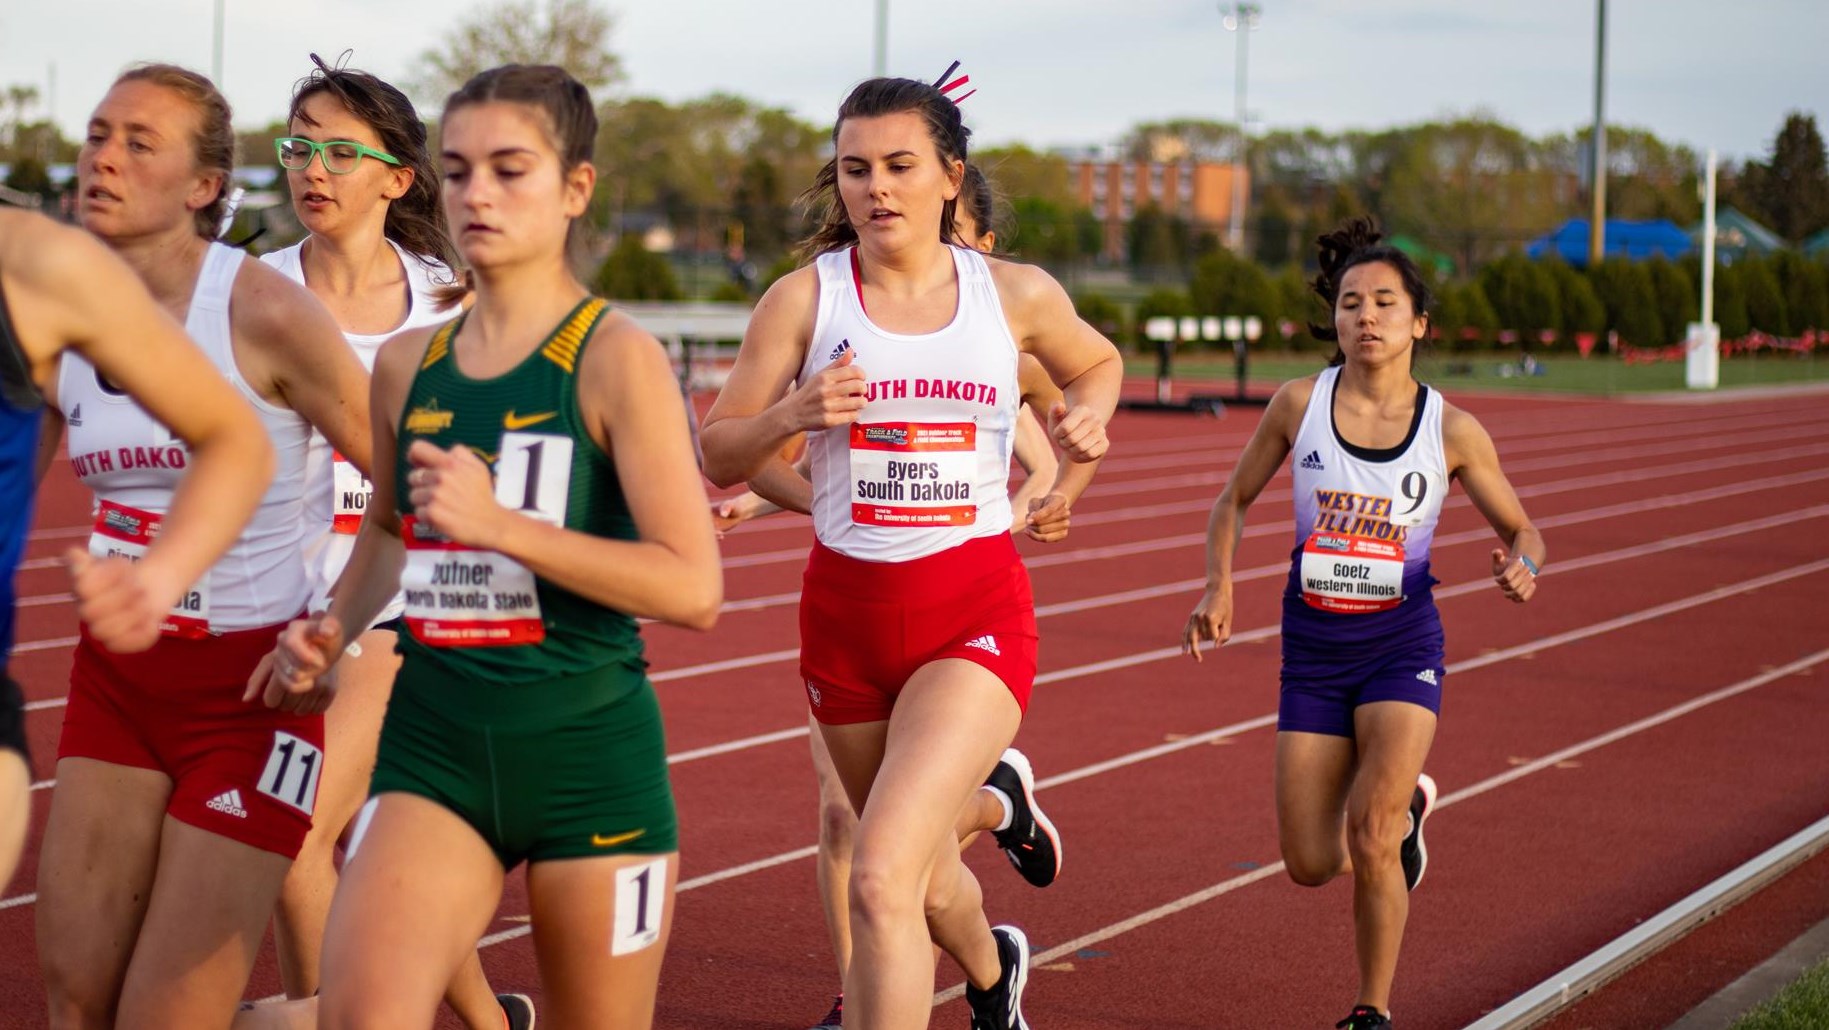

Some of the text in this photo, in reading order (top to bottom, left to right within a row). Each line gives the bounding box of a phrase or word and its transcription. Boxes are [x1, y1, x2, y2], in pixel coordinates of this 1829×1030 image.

[863, 378, 997, 406] UTH DAKOTA
[71, 446, 187, 478] UTH DAKO
[518, 440, 547, 512] 1
[887, 460, 939, 481] Byers
[1300, 462, 1325, 471] adidas
[857, 479, 970, 501] South Dakota
[1315, 489, 1393, 518] WESTE
[1397, 471, 1428, 515] 9
[1314, 512, 1408, 542] ILLINOIS
[1333, 562, 1371, 580] Goetz
[440, 591, 489, 609] Dakota
[494, 591, 533, 610] State
[1306, 578, 1396, 596] Western Illinois
[271, 738, 318, 807] 11
[205, 799, 248, 819] adidas
[626, 866, 651, 938] 1
